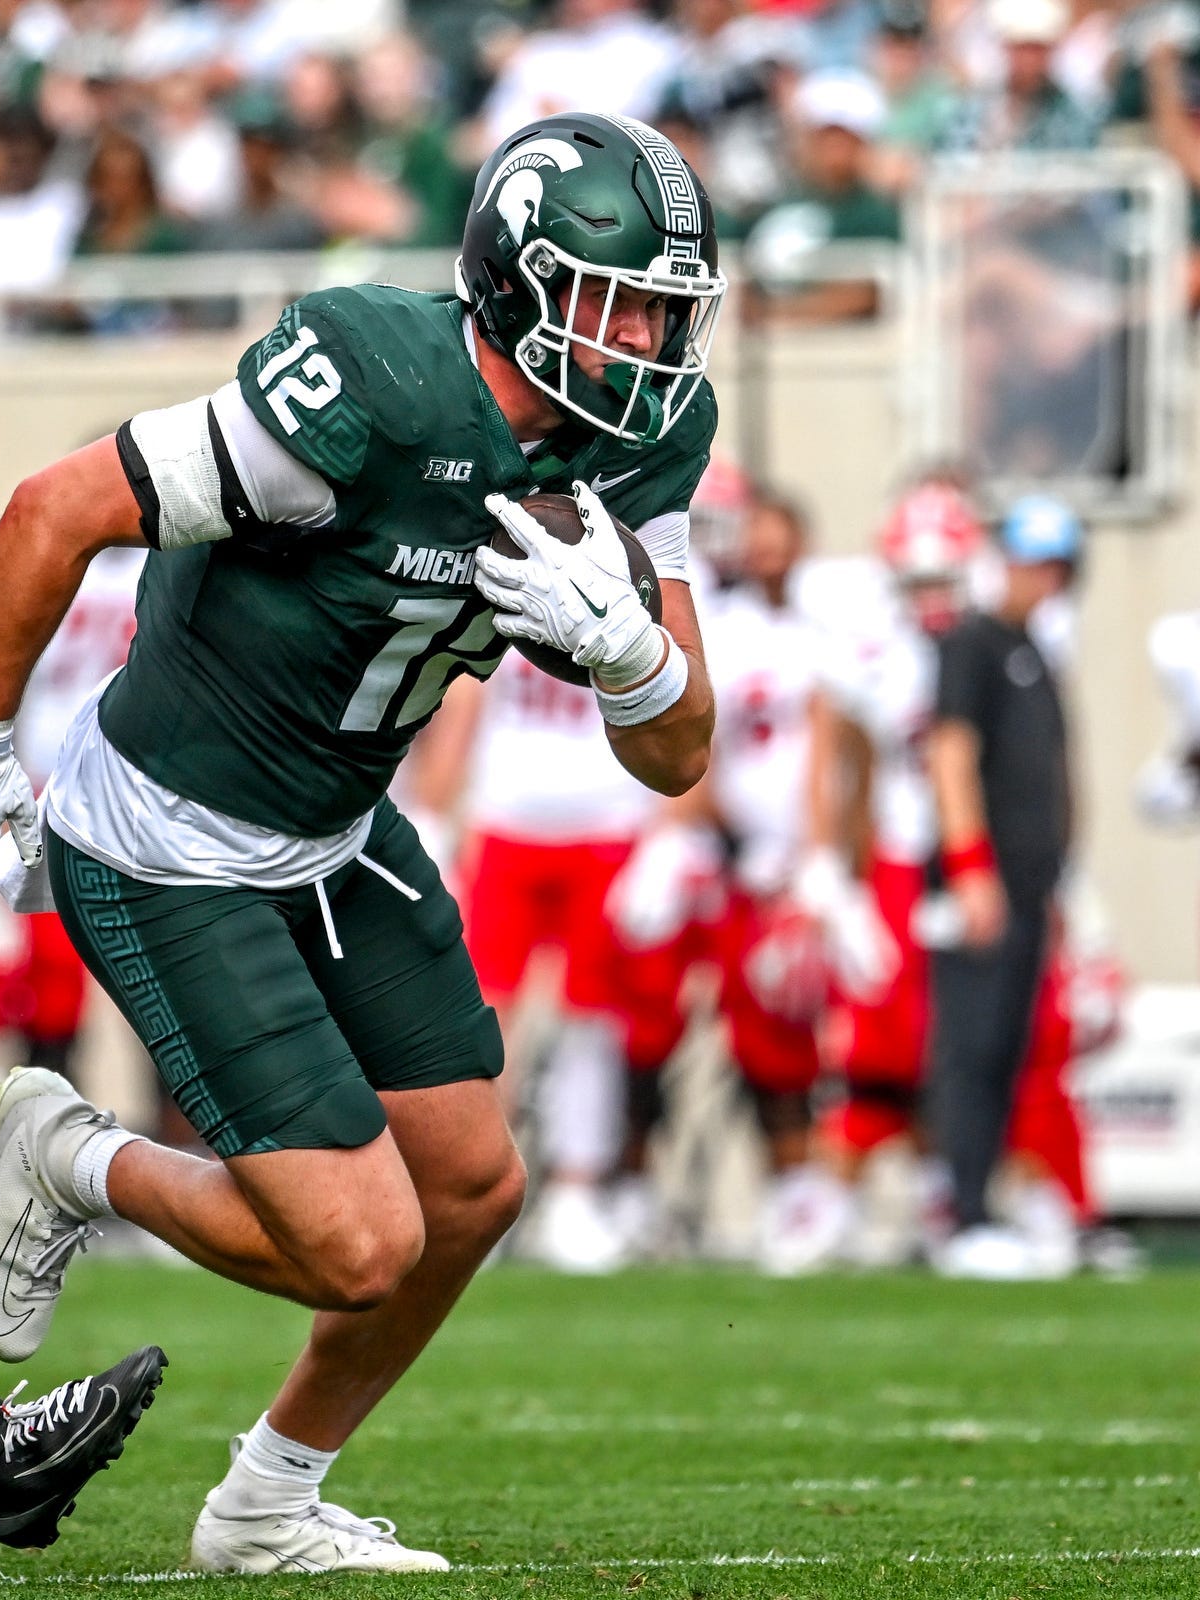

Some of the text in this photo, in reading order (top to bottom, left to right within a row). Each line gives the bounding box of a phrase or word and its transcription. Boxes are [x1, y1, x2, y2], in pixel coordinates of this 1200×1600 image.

[669, 260, 702, 278] STATE
[256, 325, 342, 436] 12
[384, 543, 477, 585] MICHI
[17, 1141, 32, 1172] VAPOR
